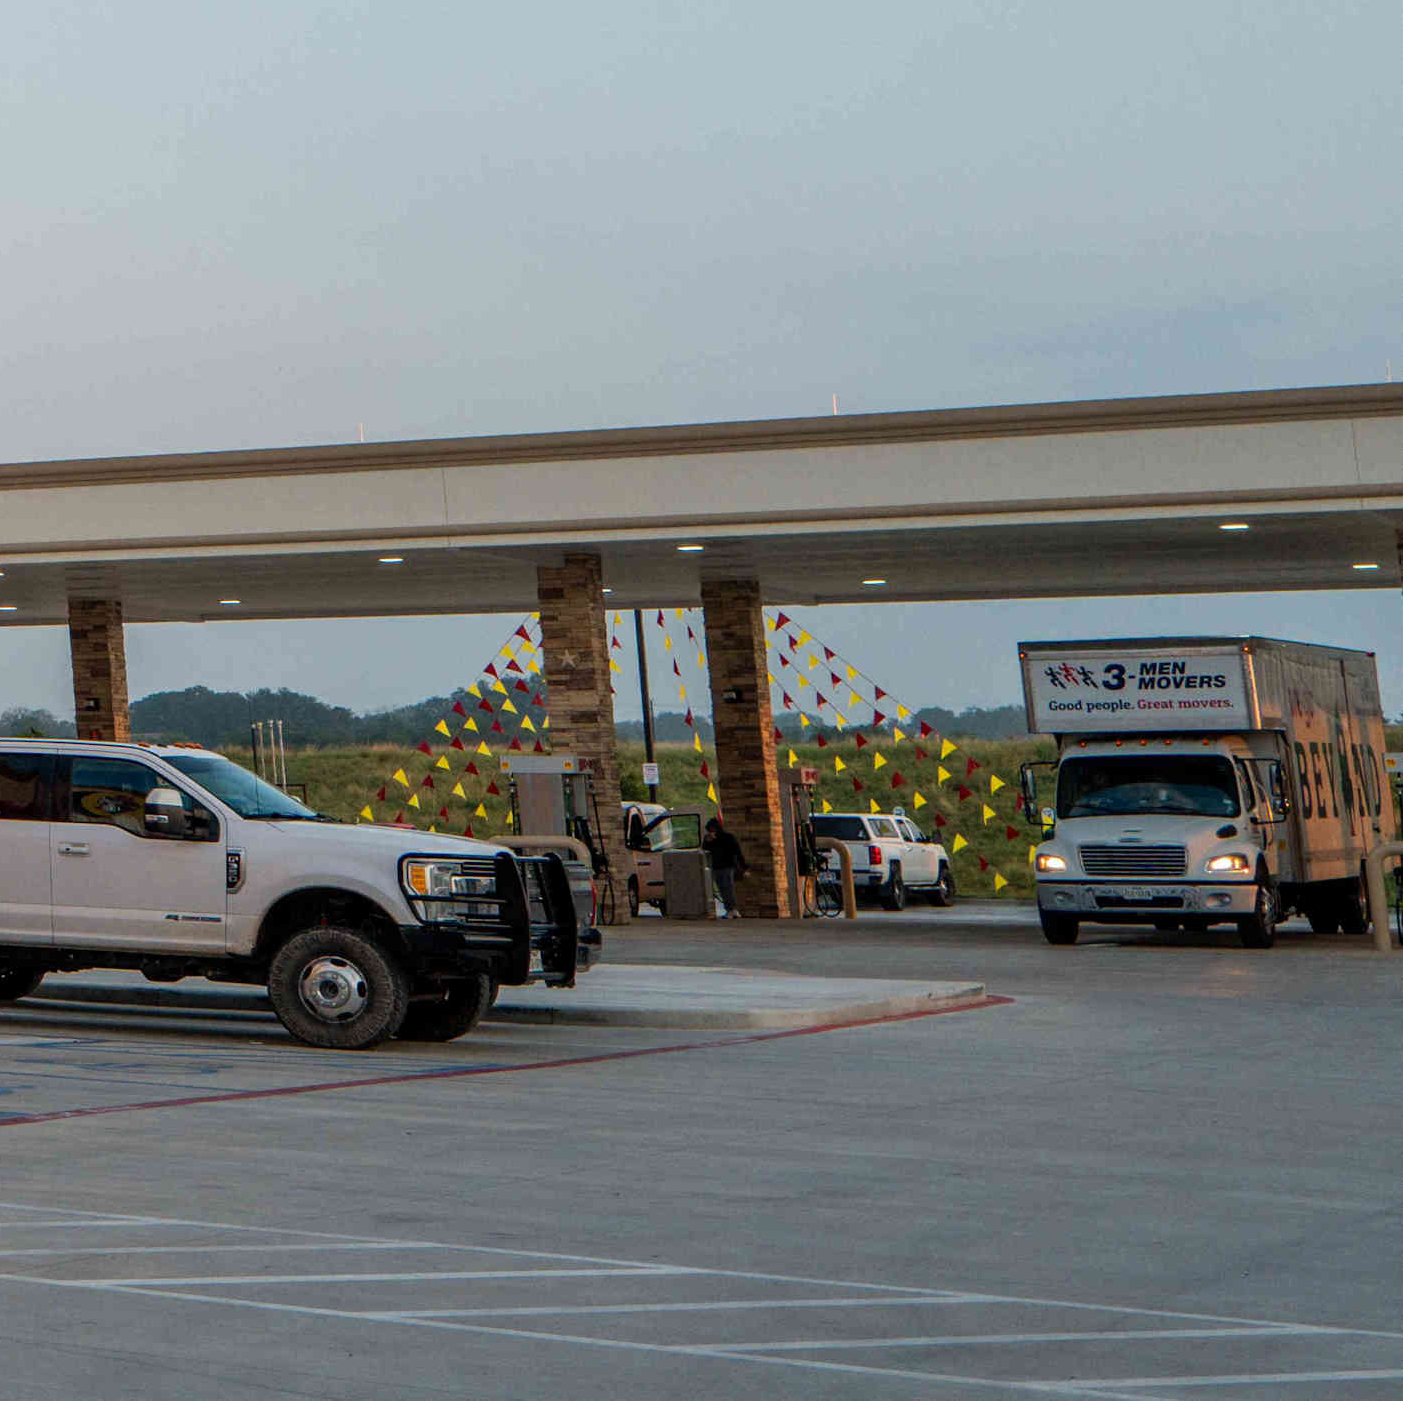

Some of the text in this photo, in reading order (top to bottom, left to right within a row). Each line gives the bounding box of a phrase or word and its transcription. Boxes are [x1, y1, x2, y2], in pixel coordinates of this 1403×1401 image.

[1139, 661, 1186, 676] MEN
[1138, 674, 1226, 690] MOVERS
[1048, 699, 1234, 717] Good people. Great movers.
